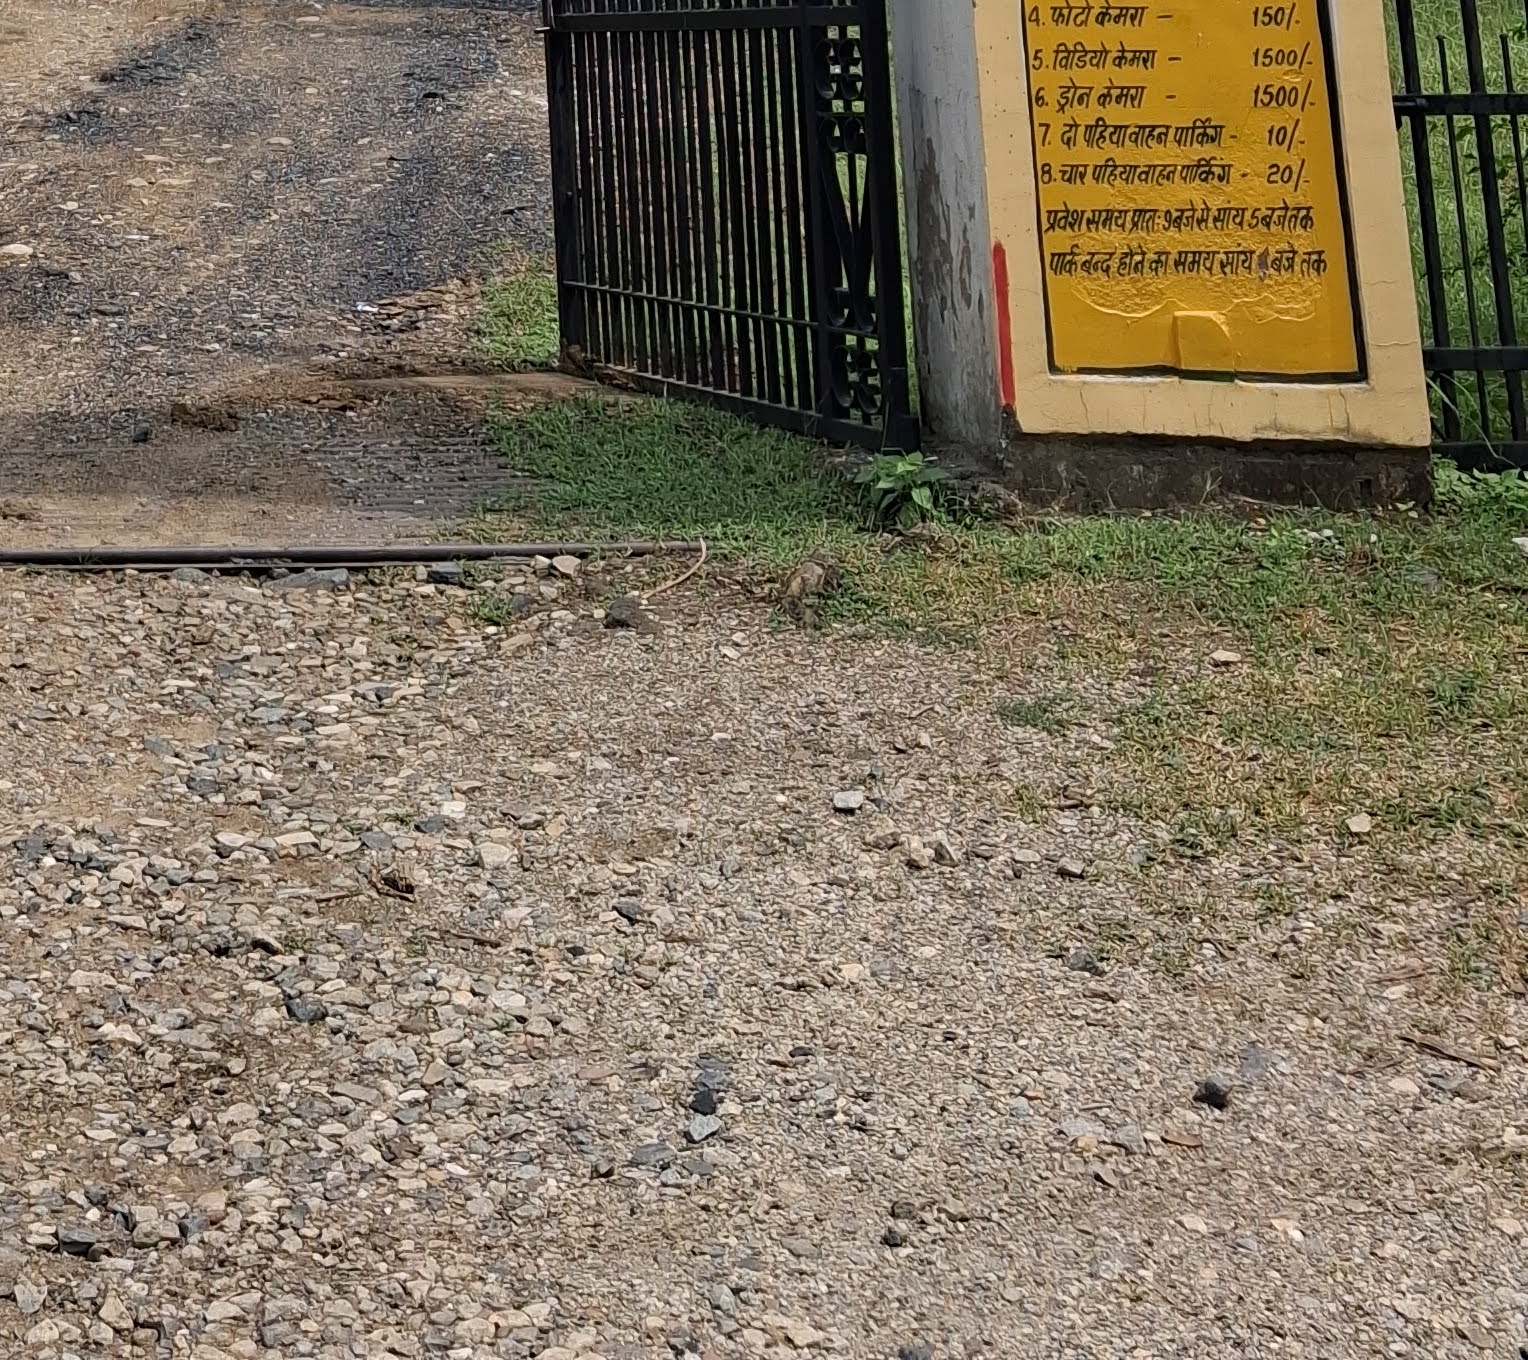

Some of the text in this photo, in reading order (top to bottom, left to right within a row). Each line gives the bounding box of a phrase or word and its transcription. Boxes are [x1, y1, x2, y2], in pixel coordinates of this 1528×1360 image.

[1028, 6, 1045, 26] 4.
[1252, 3, 1301, 31] 150/-
[1052, 41, 1313, 70] विडियो केमरा 1500/-
[1056, 78, 1316, 114] ड्रोन केमरा 1500/-
[1061, 116, 1306, 152] दो पहिया वाहन पार्किंग 10/-
[1058, 157, 1310, 192] चार पहिया वाहन पार्किंग 20/-
[1045, 201, 1128, 232] प्रवेश समय
[1050, 243, 1327, 278] पार्क बन्द होने का समय सांय बजे तक
